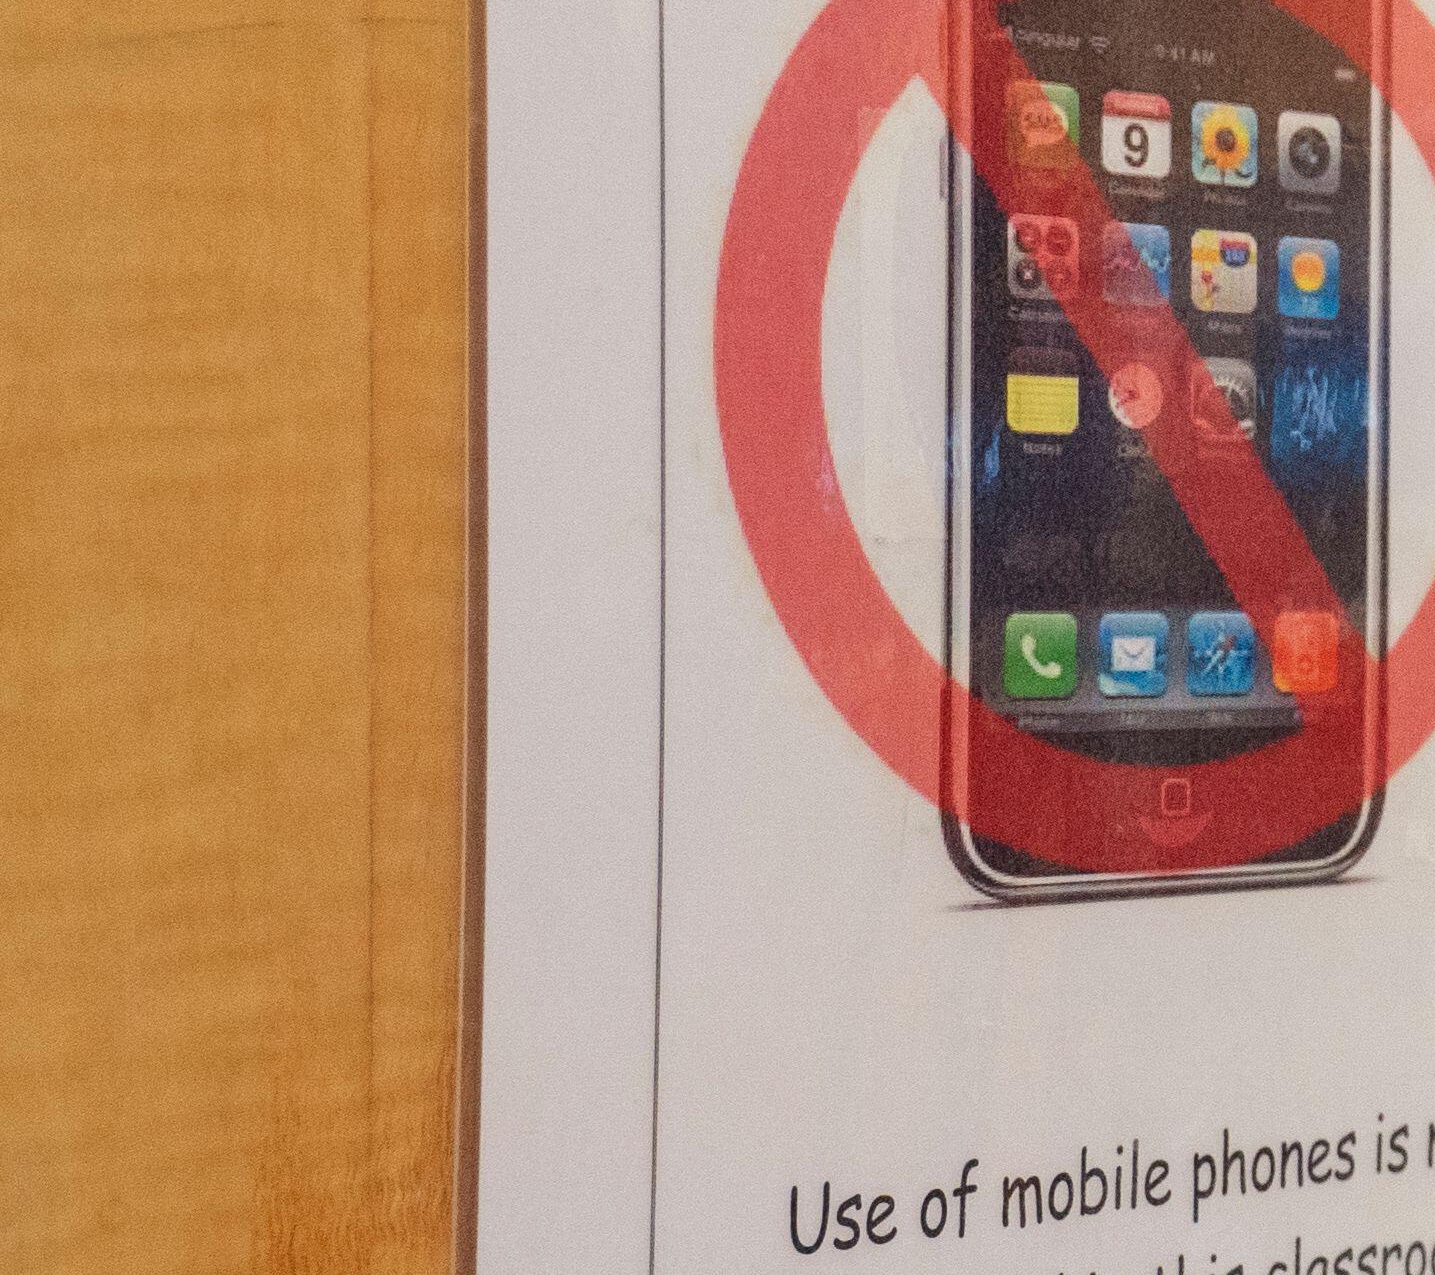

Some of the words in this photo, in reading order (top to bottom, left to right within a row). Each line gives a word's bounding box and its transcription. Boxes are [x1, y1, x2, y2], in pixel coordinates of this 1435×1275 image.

[1122, 123, 1150, 167] 9
[789, 1181, 898, 1256] Use
[919, 1157, 980, 1239] of
[1001, 1139, 1172, 1228] mobile
[1192, 1128, 1358, 1223] phones
[1375, 1114, 1410, 1174] is
